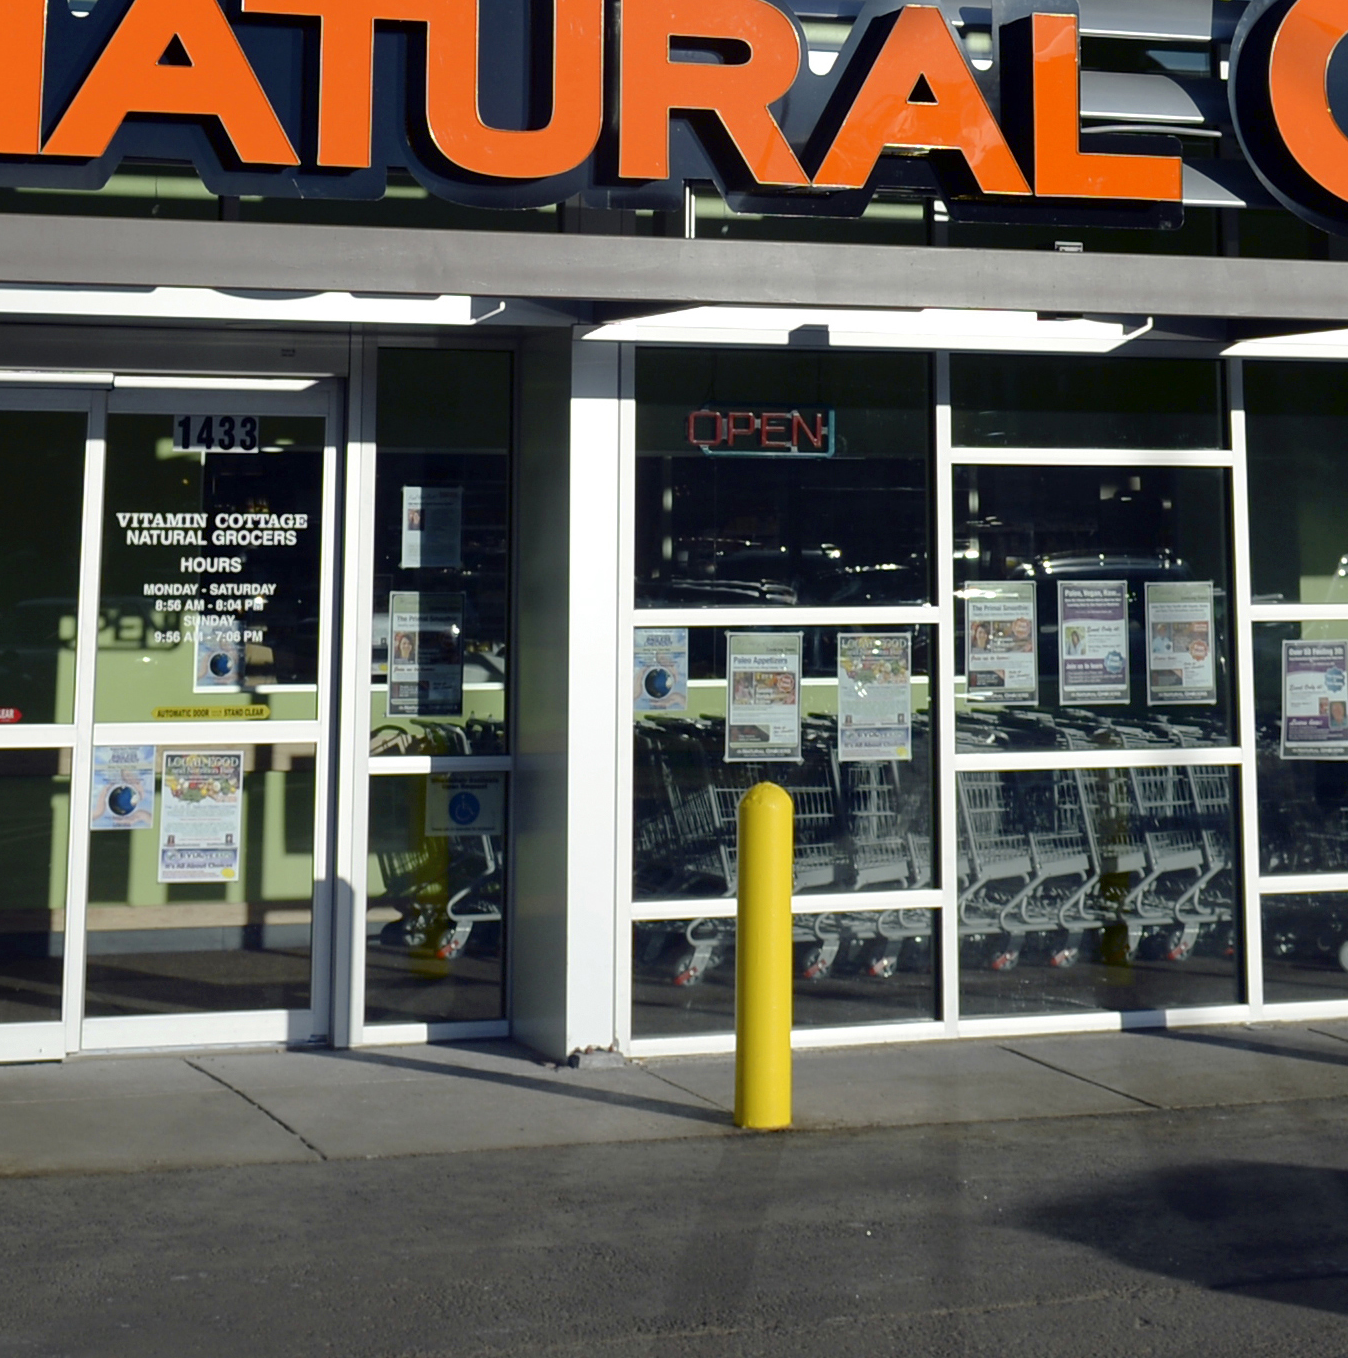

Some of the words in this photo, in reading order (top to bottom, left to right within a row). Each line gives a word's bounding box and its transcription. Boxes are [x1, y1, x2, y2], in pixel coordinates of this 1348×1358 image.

[178, 415, 258, 450] 1433
[687, 410, 823, 448] OPEN
[116, 512, 208, 529] VITAMIN
[215, 513, 309, 529] COTTAGE
[126, 530, 208, 546] NATURAL
[212, 530, 298, 546] GROCERS
[180, 557, 242, 573] HOURS
[143, 583, 199, 596] MONDAY
[209, 583, 277, 596] SATURDAY
[155, 599, 182, 612] 8:56
[183, 599, 205, 612] AM
[215, 599, 242, 612] 8:04
[244, 599, 264, 612] PM
[183, 615, 236, 627] SUNDAY
[154, 631, 181, 643] 9:56
[245, 631, 263, 643] PM
[157, 709, 192, 718] AUTOMATIC
[193, 709, 209, 717] DOOR
[223, 708, 243, 717] STAND
[244, 708, 264, 716] CLEAR
[208, 756, 239, 767] FOOD
